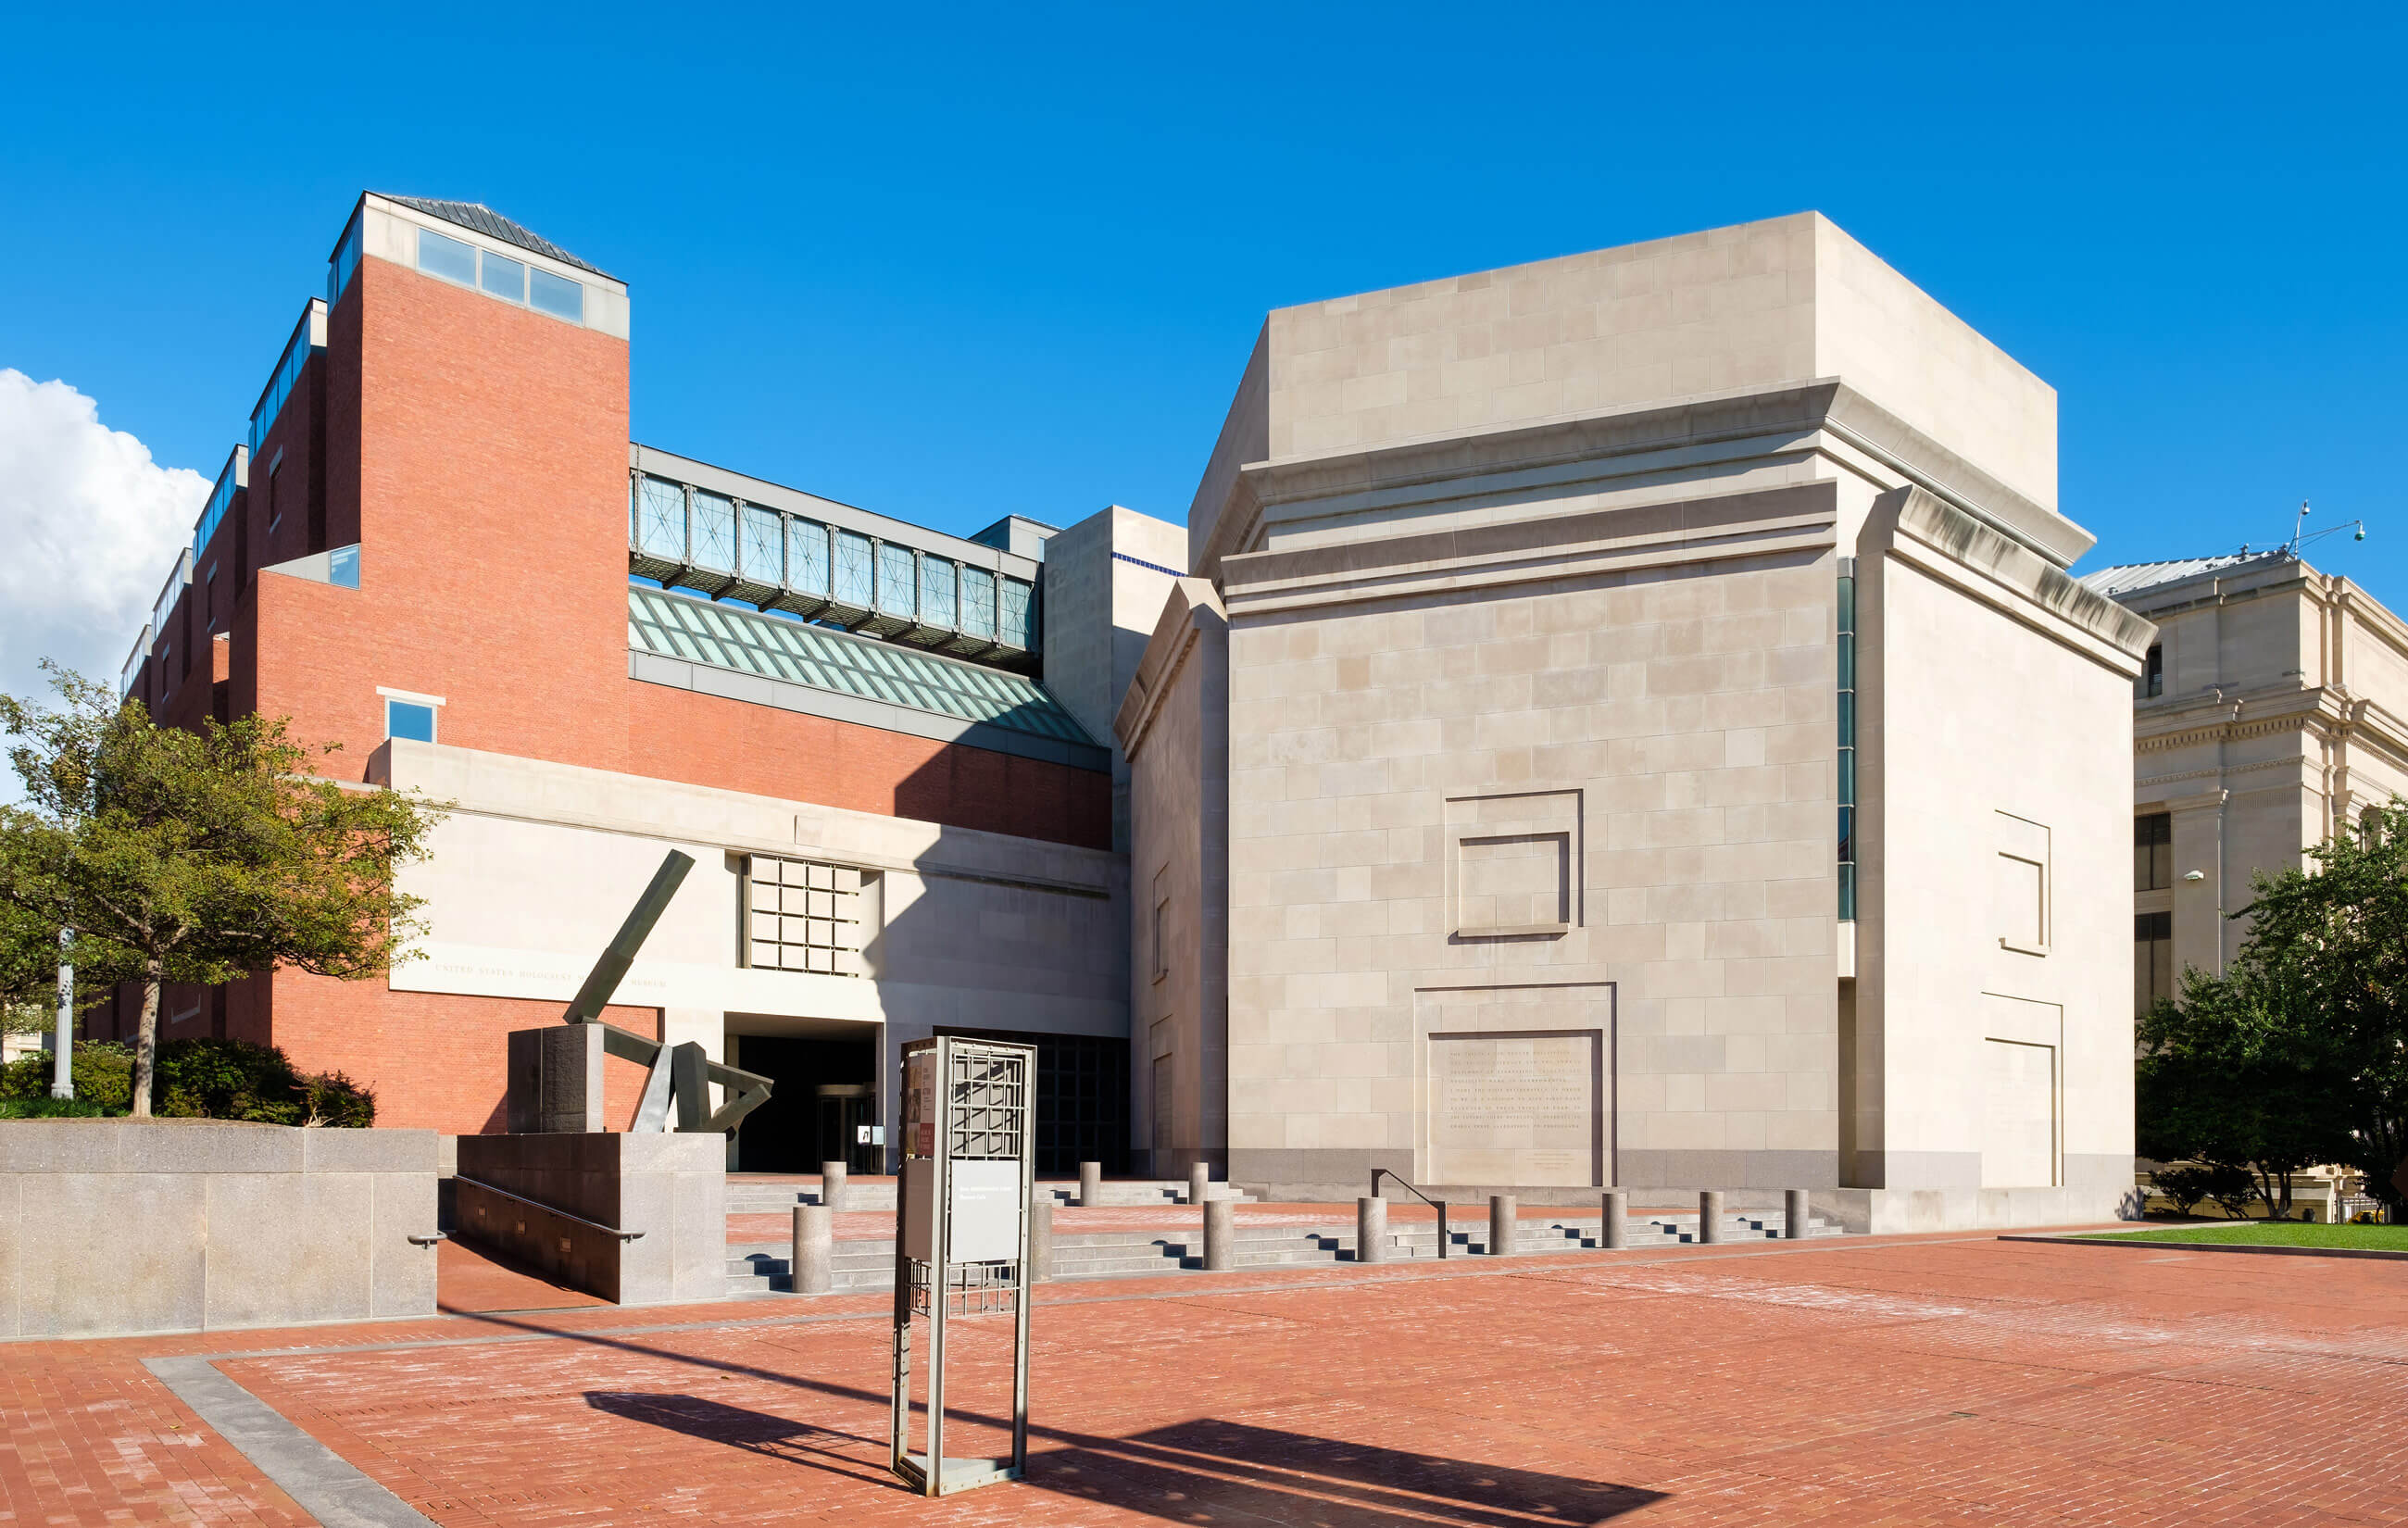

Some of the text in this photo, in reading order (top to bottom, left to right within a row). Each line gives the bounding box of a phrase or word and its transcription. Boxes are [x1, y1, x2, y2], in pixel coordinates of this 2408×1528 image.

[435, 963, 475, 974] UNITED
[479, 967, 514, 977] STATES
[519, 970, 571, 981] HOLOCAUST
